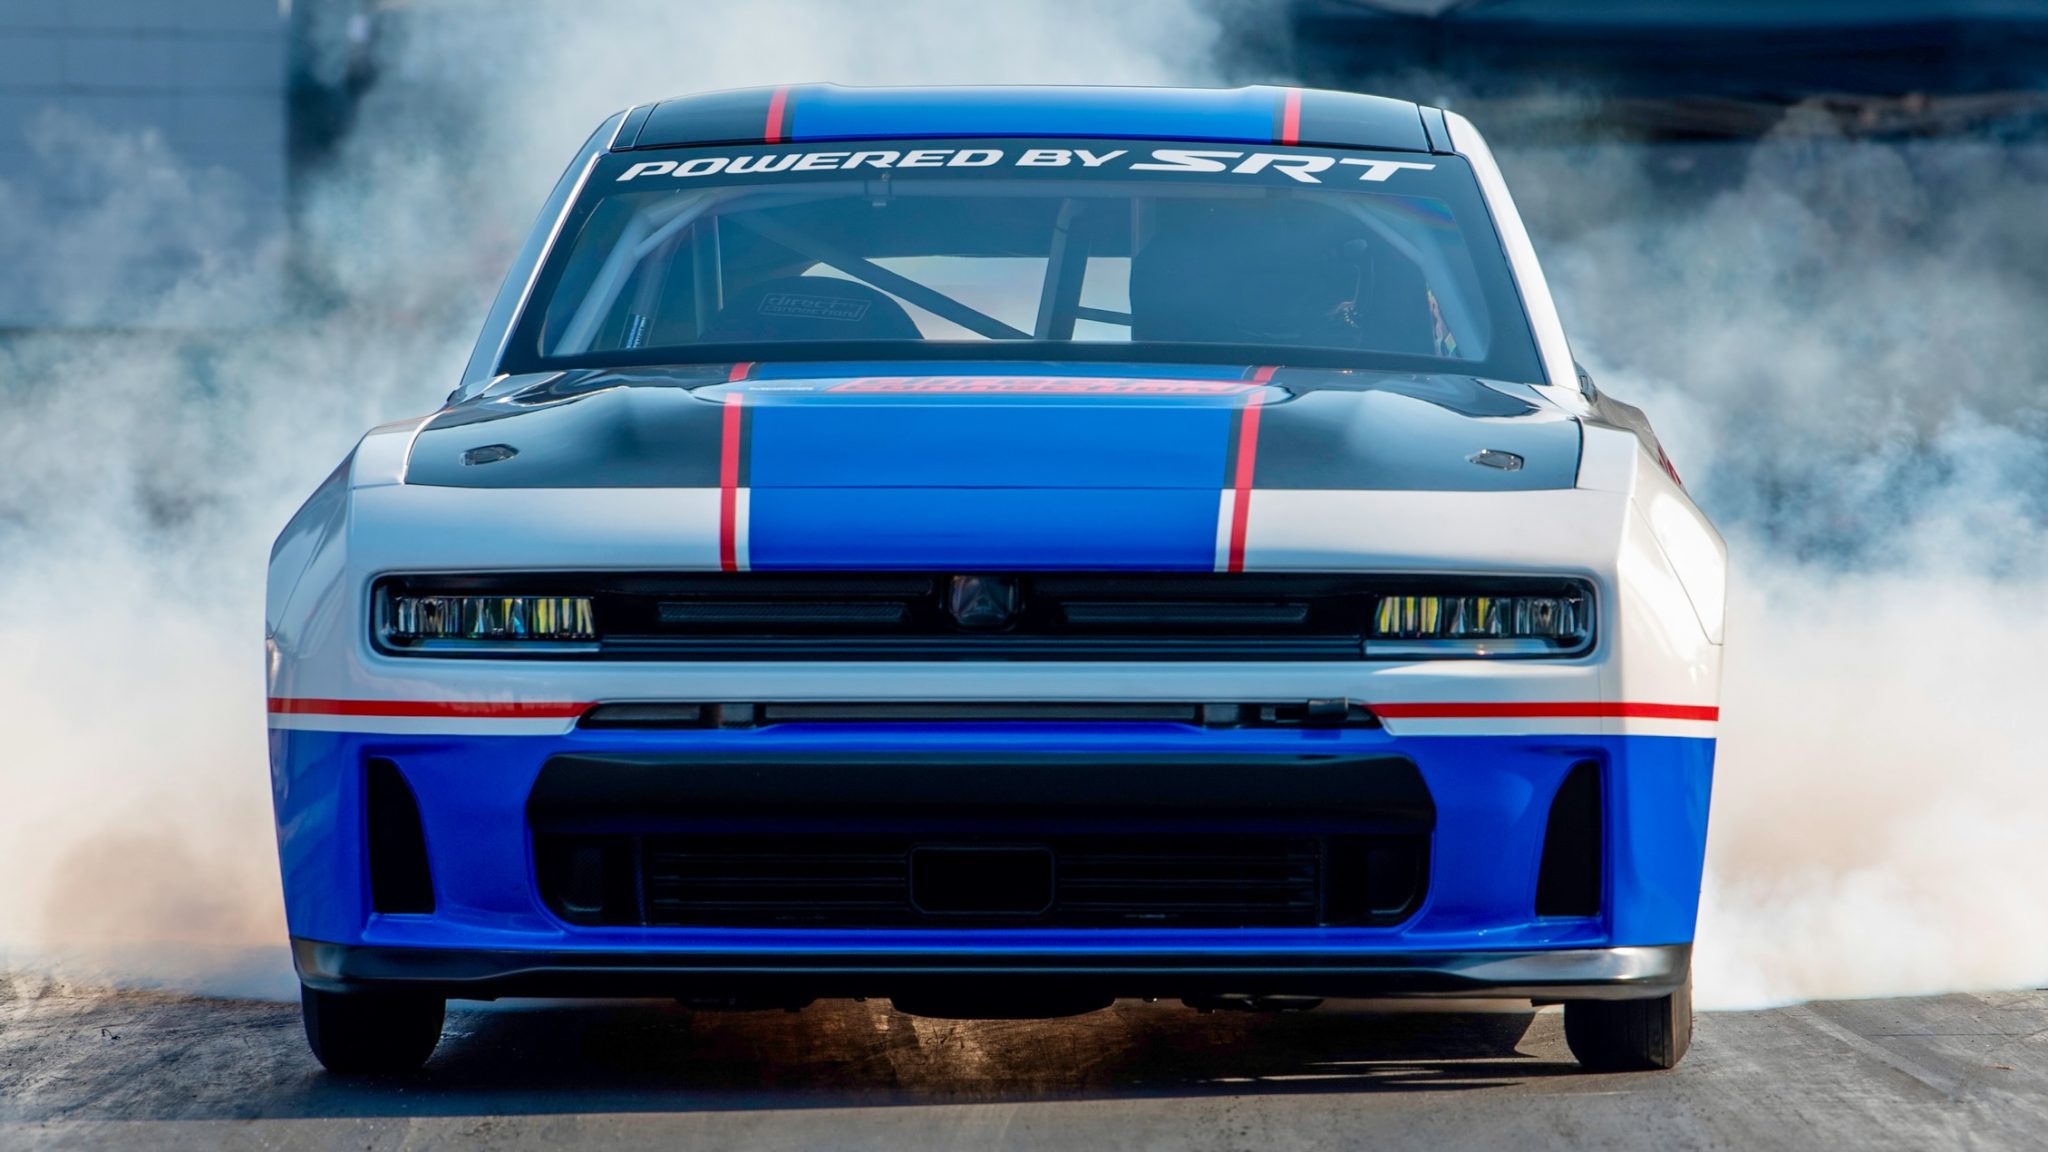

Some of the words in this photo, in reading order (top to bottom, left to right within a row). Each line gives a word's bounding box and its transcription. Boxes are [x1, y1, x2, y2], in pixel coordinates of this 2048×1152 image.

[616, 149, 1004, 182] POWERED
[1015, 149, 1128, 167] BY
[1129, 149, 1436, 183] SRT
